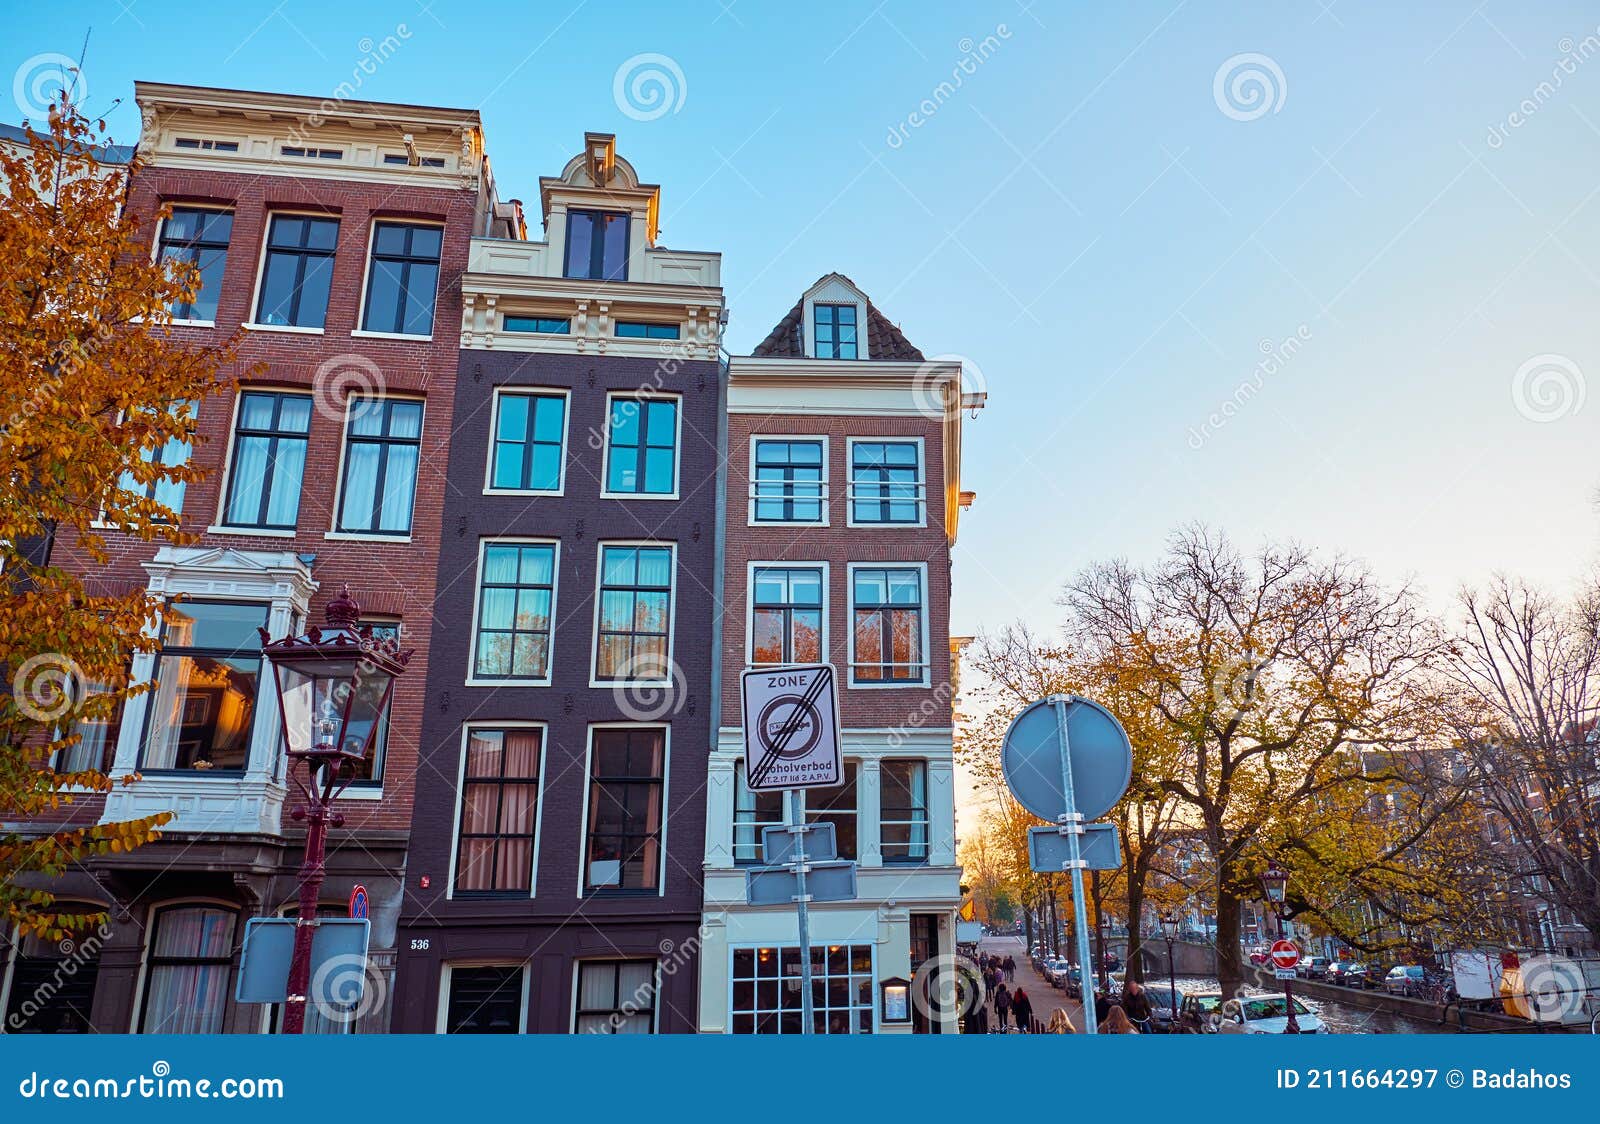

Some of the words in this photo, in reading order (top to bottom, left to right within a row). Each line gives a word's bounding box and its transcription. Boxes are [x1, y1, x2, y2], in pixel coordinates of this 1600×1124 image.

[767, 675, 808, 688] ZONE
[754, 760, 832, 777] oholverbod
[410, 939, 430, 950] 536
